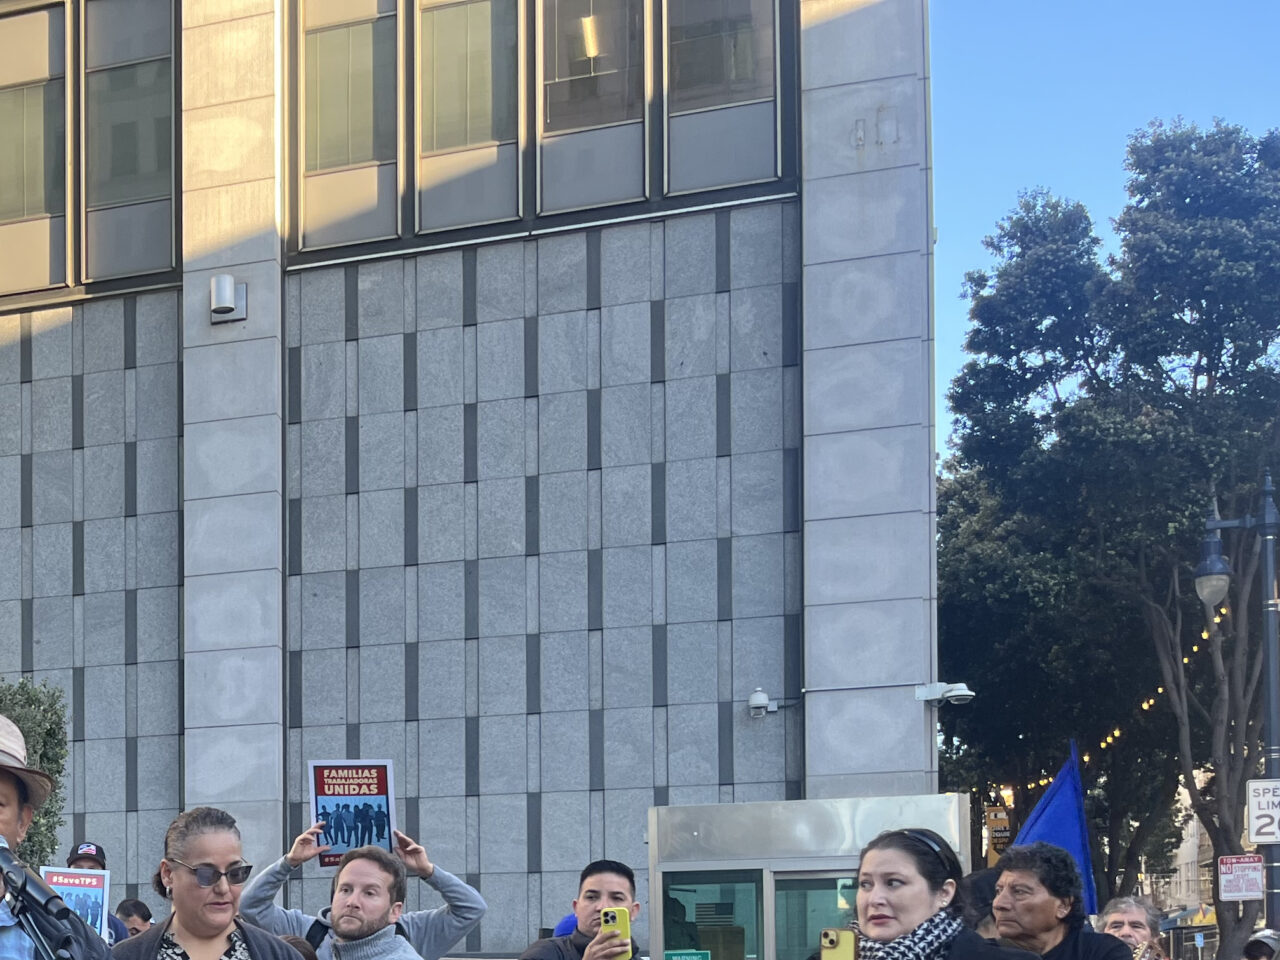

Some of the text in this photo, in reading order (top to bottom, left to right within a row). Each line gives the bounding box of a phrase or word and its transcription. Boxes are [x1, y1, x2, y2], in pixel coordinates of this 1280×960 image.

[324, 769, 378, 778] FAMILIAS
[324, 784, 378, 795] UNIDAS
[1252, 788, 1280, 798] SPE
[1258, 801, 1280, 810] LIM
[1255, 814, 1280, 836] 2
[1220, 864, 1232, 874] NO
[52, 876, 97, 885] #SaveTPS
